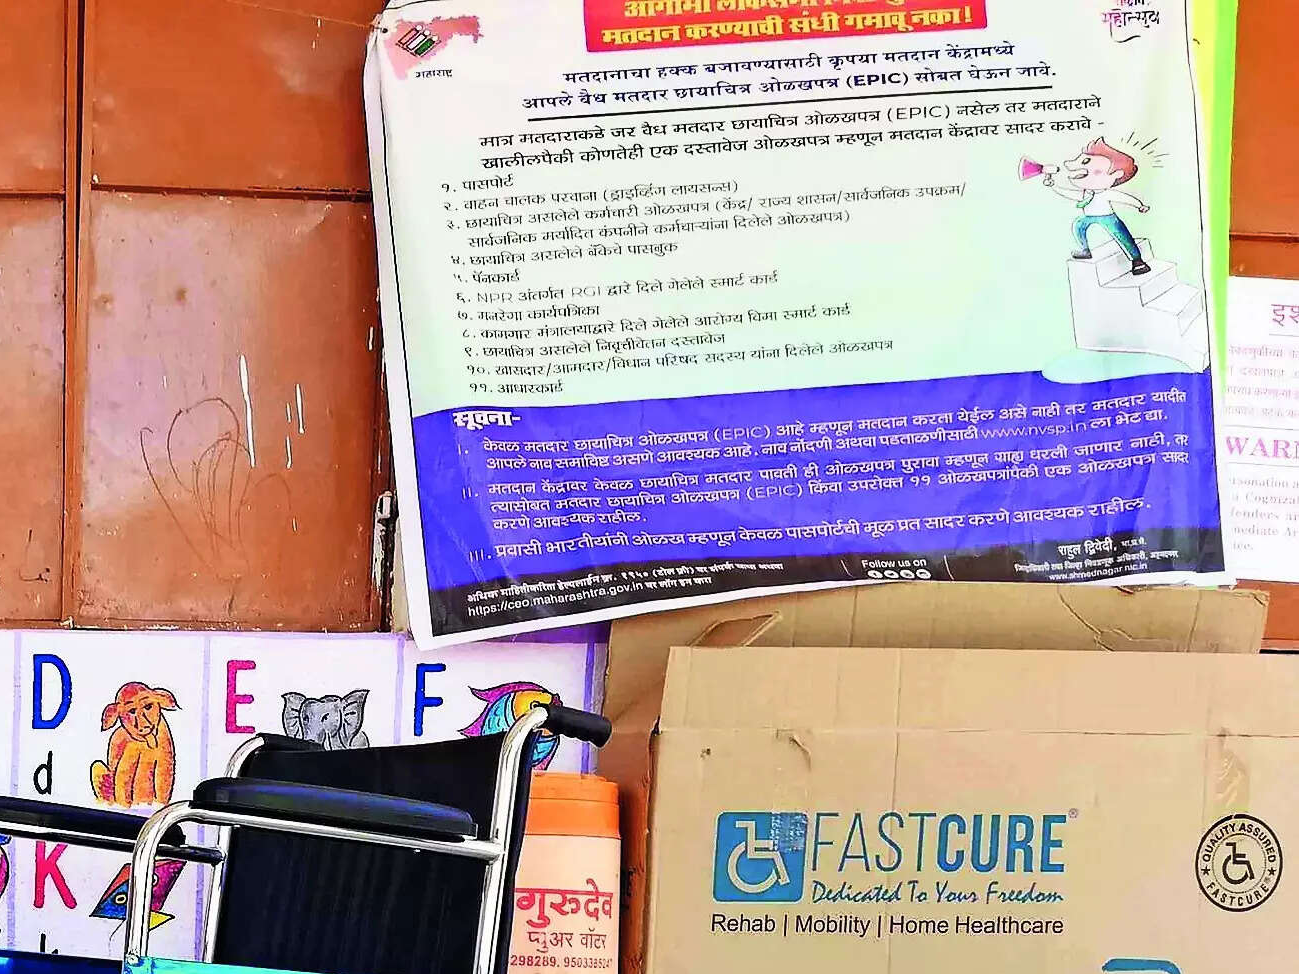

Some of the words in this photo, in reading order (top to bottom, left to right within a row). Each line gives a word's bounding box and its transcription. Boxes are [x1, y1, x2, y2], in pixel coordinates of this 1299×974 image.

[601, 25, 681, 44] मतदान
[789, 10, 840, 34] संधी
[884, 49, 941, 63] मतदान
[522, 91, 573, 109] आपले
[613, 89, 668, 104] मतदार
[846, 71, 909, 88] (EPIC)
[886, 104, 951, 122] (EPIC)
[714, 425, 771, 441] (EPIC)
[980, 421, 1087, 440] www.nvsp.in
[862, 559, 895, 568] Follow
[898, 560, 911, 568] us
[913, 559, 927, 567] on
[32, 654, 72, 730] D
[225, 660, 256, 735] E
[415, 663, 446, 736] F
[33, 751, 53, 795] d
[811, 812, 1066, 874] FASTCURE
[1202, 822, 1237, 863] QUALITY
[1238, 822, 1277, 863] ASSURED
[33, 841, 77, 909] K
[811, 881, 902, 904] Dedicated
[909, 882, 928, 903] To
[935, 881, 979, 904] Your
[986, 882, 1064, 905] Freedom
[1206, 881, 1270, 907] FASTCURE
[711, 914, 776, 934] Rehab
[794, 914, 871, 938] Mobility
[889, 917, 949, 935] Home
[955, 915, 1064, 935] Healthcare
